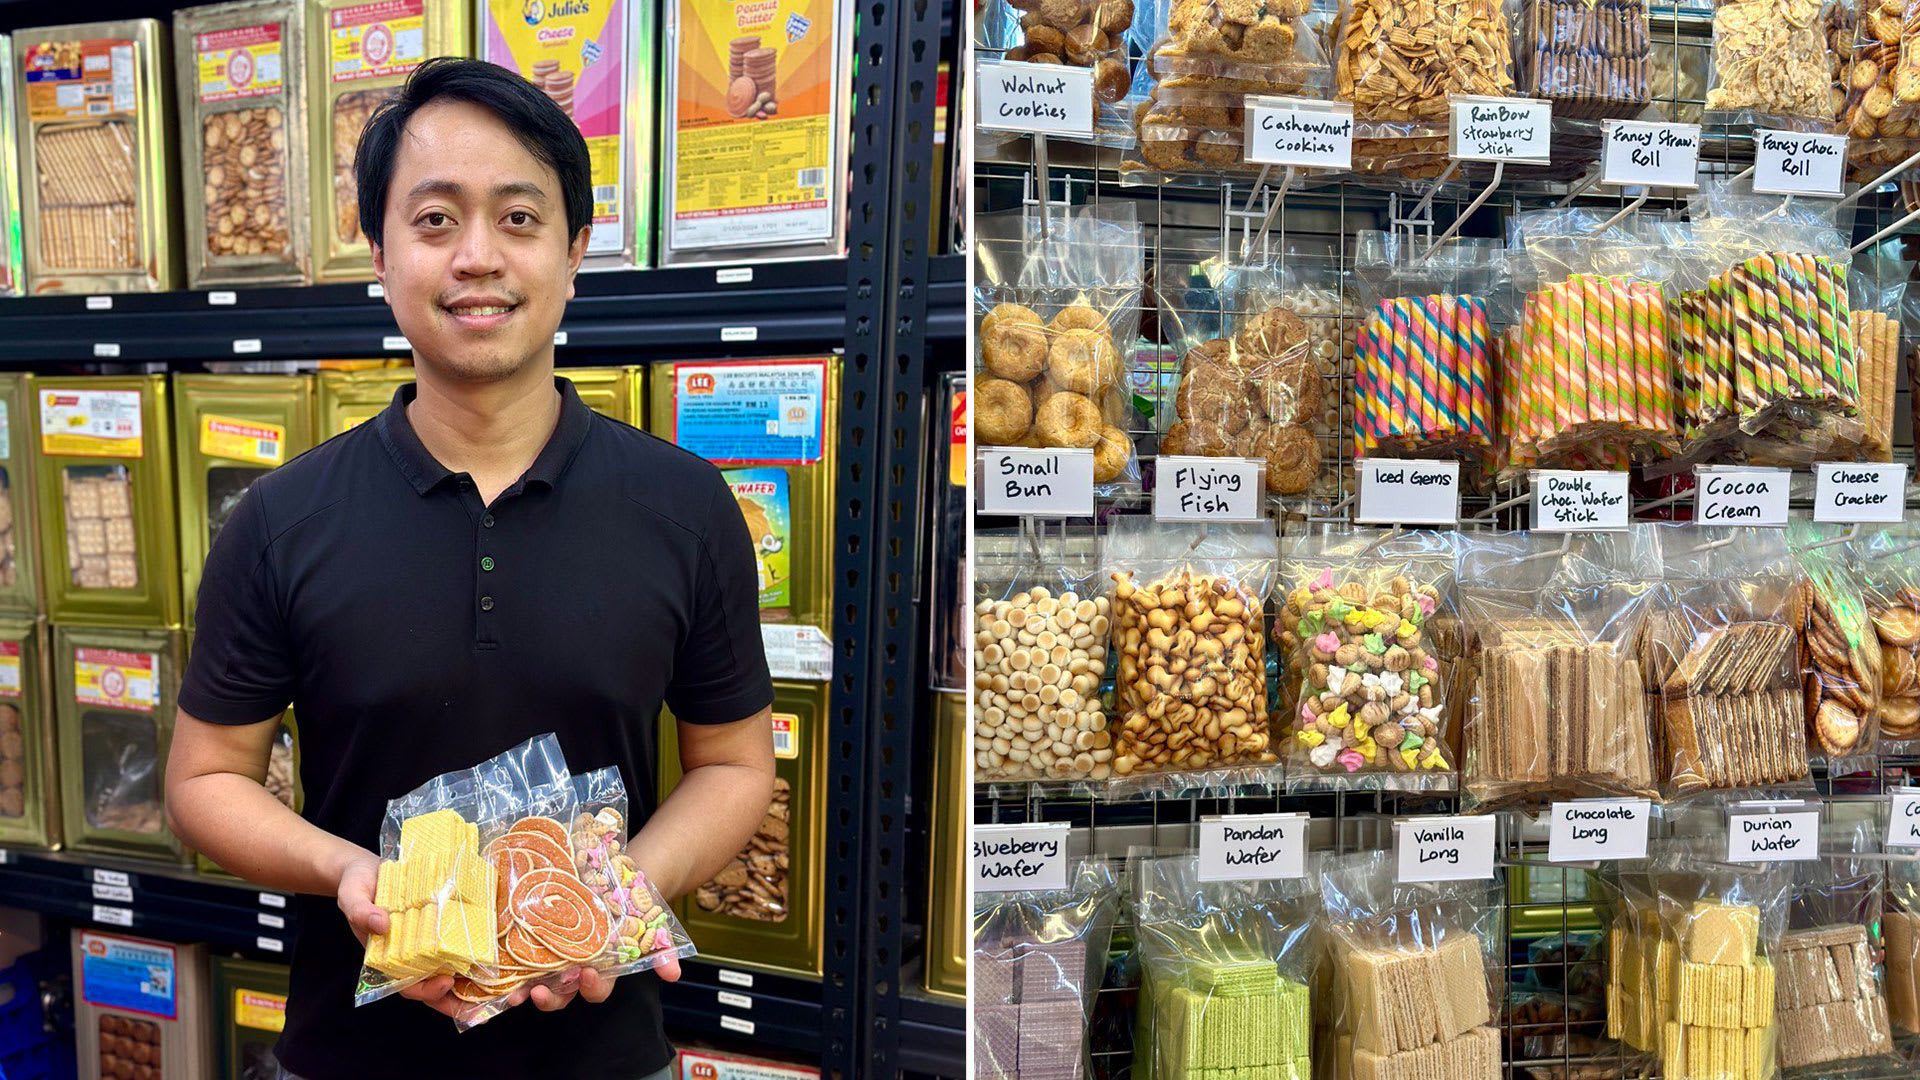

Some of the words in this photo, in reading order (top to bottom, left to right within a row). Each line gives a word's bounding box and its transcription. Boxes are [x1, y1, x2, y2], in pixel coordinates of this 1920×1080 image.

[547, 0, 589, 18] Julie's
[736, 1, 777, 15] Peanut
[738, 13, 774, 27] Butter
[538, 27, 574, 40] Cheese
[1001, 75, 1066, 95] Walnut
[999, 100, 1067, 121] Cookies
[1470, 105, 1530, 123] RainBow
[1261, 114, 1352, 136] Cashewnut
[1273, 136, 1336, 154] Cookies
[1612, 125, 1653, 147] Fancy
[1658, 129, 1696, 148] Straw.
[1762, 133, 1799, 156] Fancy
[1802, 138, 1838, 156] Choc.
[1631, 148, 1660, 168] Roll
[1781, 155, 1811, 177] Roll
[692, 377, 709, 388] LEE
[999, 455, 1059, 476] Small
[1175, 467, 1241, 493] Flying
[1375, 468, 1404, 485] Iced
[1409, 470, 1452, 487] Gems
[1548, 476, 1592, 493] Double
[1706, 476, 1770, 495] Cocoa
[1831, 470, 1879, 484] Cheese
[737, 483, 775, 494] WAFER
[1005, 480, 1052, 499] Bun
[1180, 492, 1230, 514] Fish
[1541, 493, 1578, 508] Choc.
[1581, 491, 1623, 507] Wafer
[1834, 491, 1888, 507] Cracker
[1704, 502, 1761, 520] Cream
[1565, 805, 1636, 821] Chocolate
[1223, 824, 1284, 842] Pandan
[1572, 825, 1608, 844] Long
[1743, 818, 1793, 833] Durian
[1413, 826, 1465, 844] Vanilla
[1751, 834, 1801, 853] Wafer
[1226, 845, 1281, 866] Wafer
[1419, 848, 1459, 864] Long
[980, 858, 1045, 879] Wafer
[694, 1066, 712, 1077] LEE
